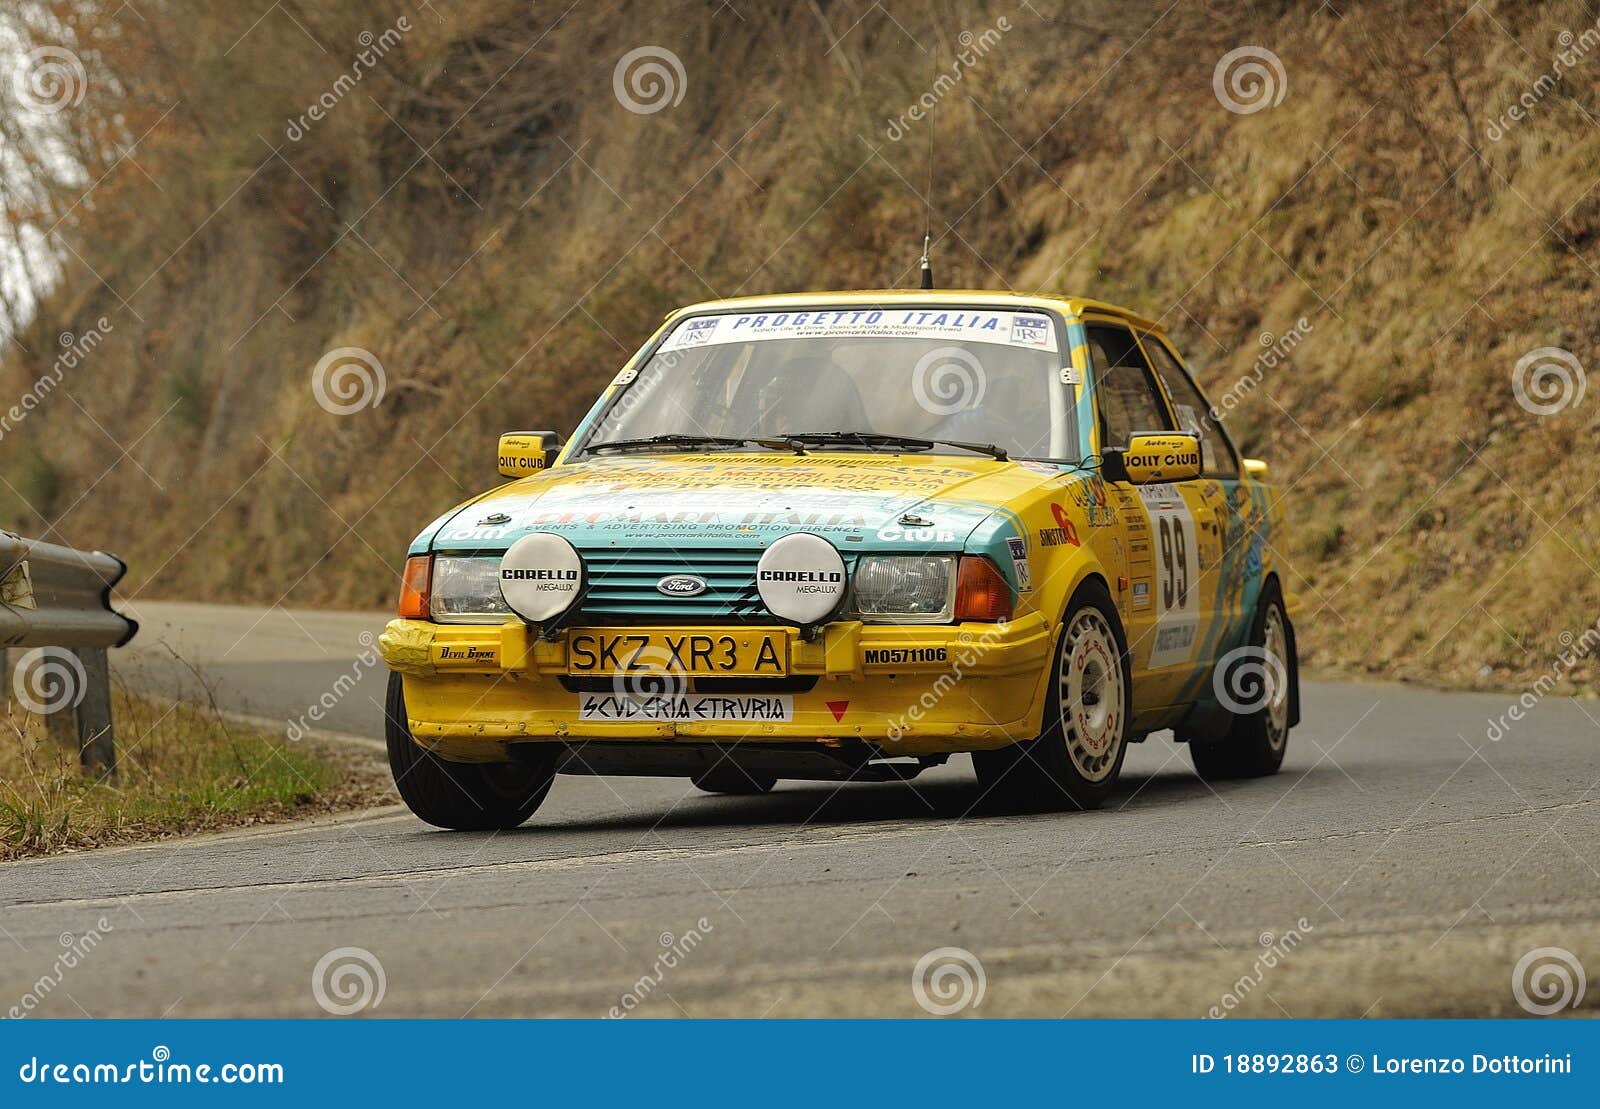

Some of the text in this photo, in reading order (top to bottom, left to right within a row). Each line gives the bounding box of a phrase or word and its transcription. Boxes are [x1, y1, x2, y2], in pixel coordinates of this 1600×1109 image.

[733, 311, 883, 329] PROGETTO
[902, 312, 999, 330] ITALIA
[1017, 329, 1043, 340] IRC
[499, 456, 544, 469] OLLY CLUB
[1126, 453, 1197, 467] JOLLY CLUB
[603, 523, 697, 531] ADVERTISING
[706, 523, 792, 531] PROMOTION
[800, 525, 861, 533] FIRENZE
[624, 532, 760, 540] www.promarkitalia.com
[877, 527, 954, 543] CLUB
[1159, 515, 1187, 610] 99
[502, 569, 577, 580] CARELLO
[760, 570, 841, 582] CARELLO
[536, 583, 573, 592] MEGALUX
[667, 578, 694, 592] Ford
[796, 584, 837, 593] MEGALUX
[572, 635, 782, 671] SKZ XR3 A
